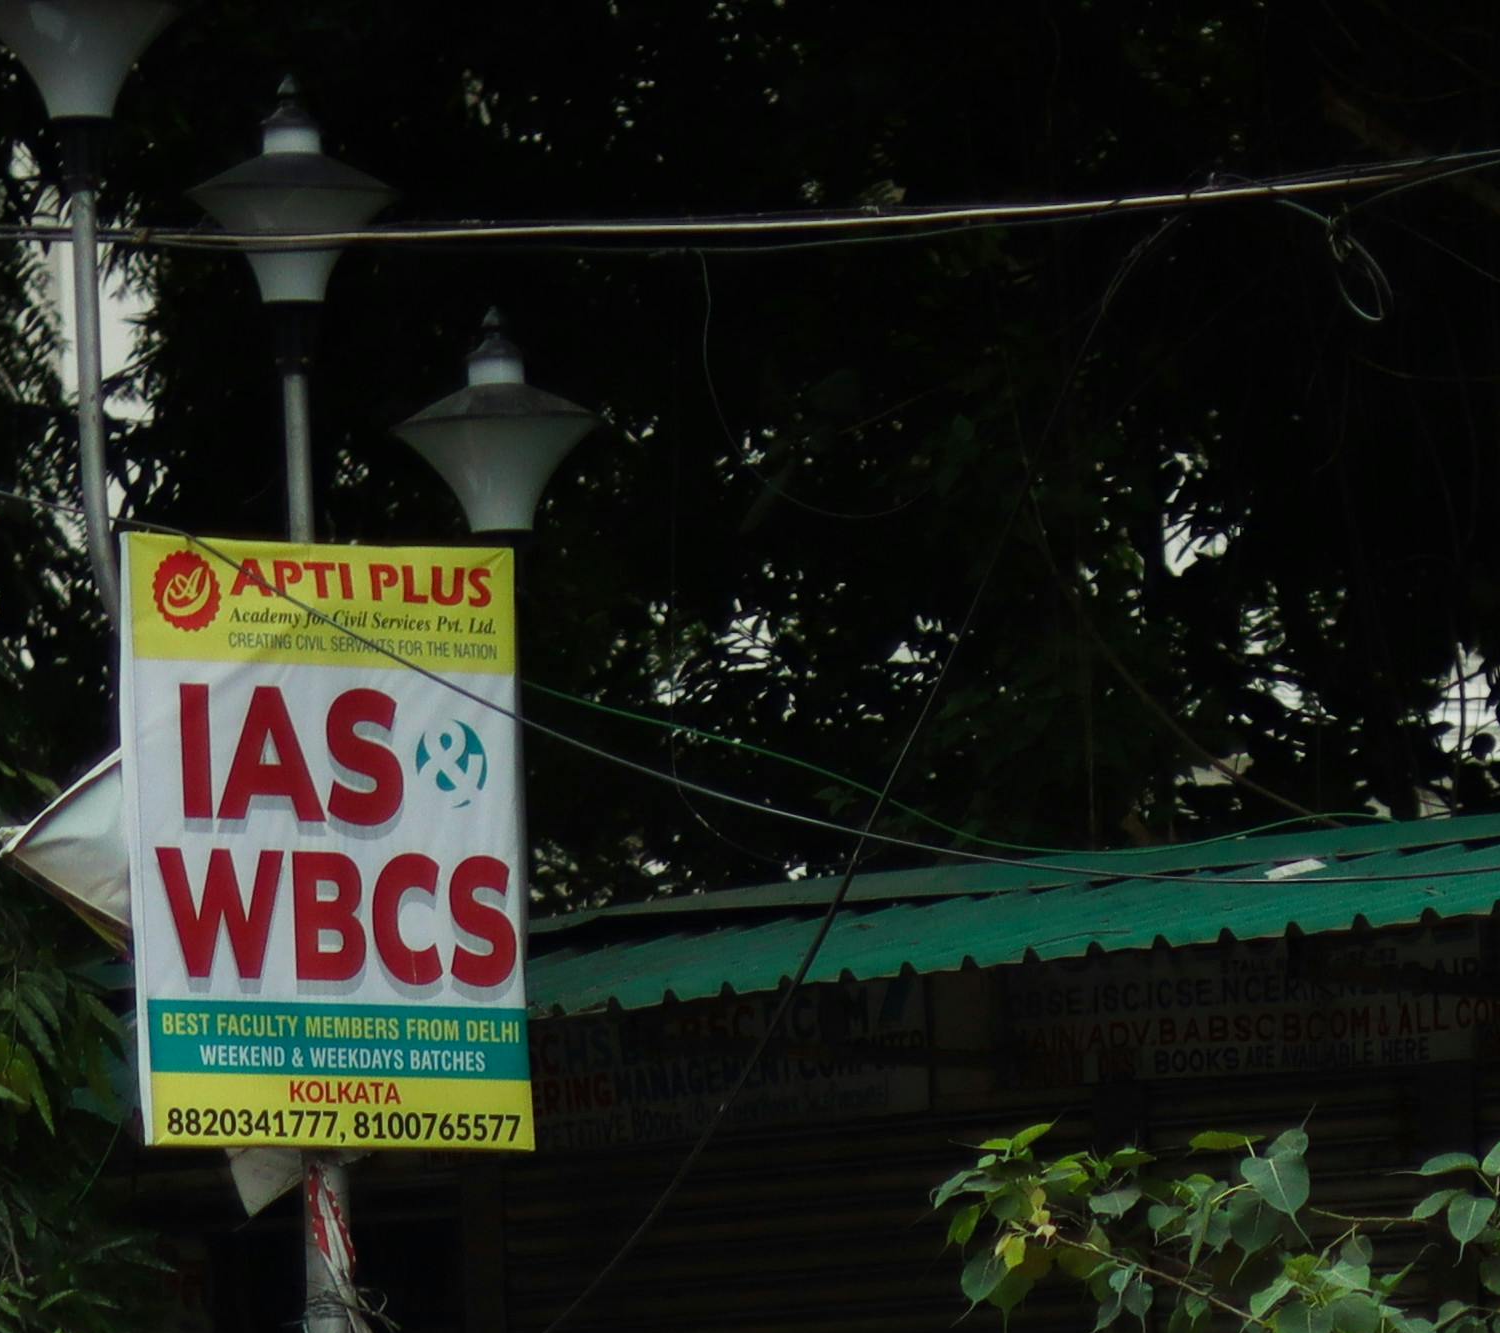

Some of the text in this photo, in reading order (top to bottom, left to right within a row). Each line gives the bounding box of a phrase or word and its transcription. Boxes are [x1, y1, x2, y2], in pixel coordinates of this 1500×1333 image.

[230, 558, 493, 608] APTI PLUS
[229, 606, 497, 634] Academy for Civil Services Pvt. Ltd.
[228, 631, 498, 660] CREATING CIVIL SERVANTS FOR THE NATION
[179, 683, 404, 828] IAS
[154, 846, 518, 989] WBCS
[161, 1012, 520, 1043] BEST FACULTY MEMBERS FROM DELHI
[199, 1044, 486, 1072] WEEKEND & WEEKDAYS BATCHES
[289, 1080, 401, 1106] KOLKATA
[166, 1109, 521, 1142] 8820341777, 8100765577
